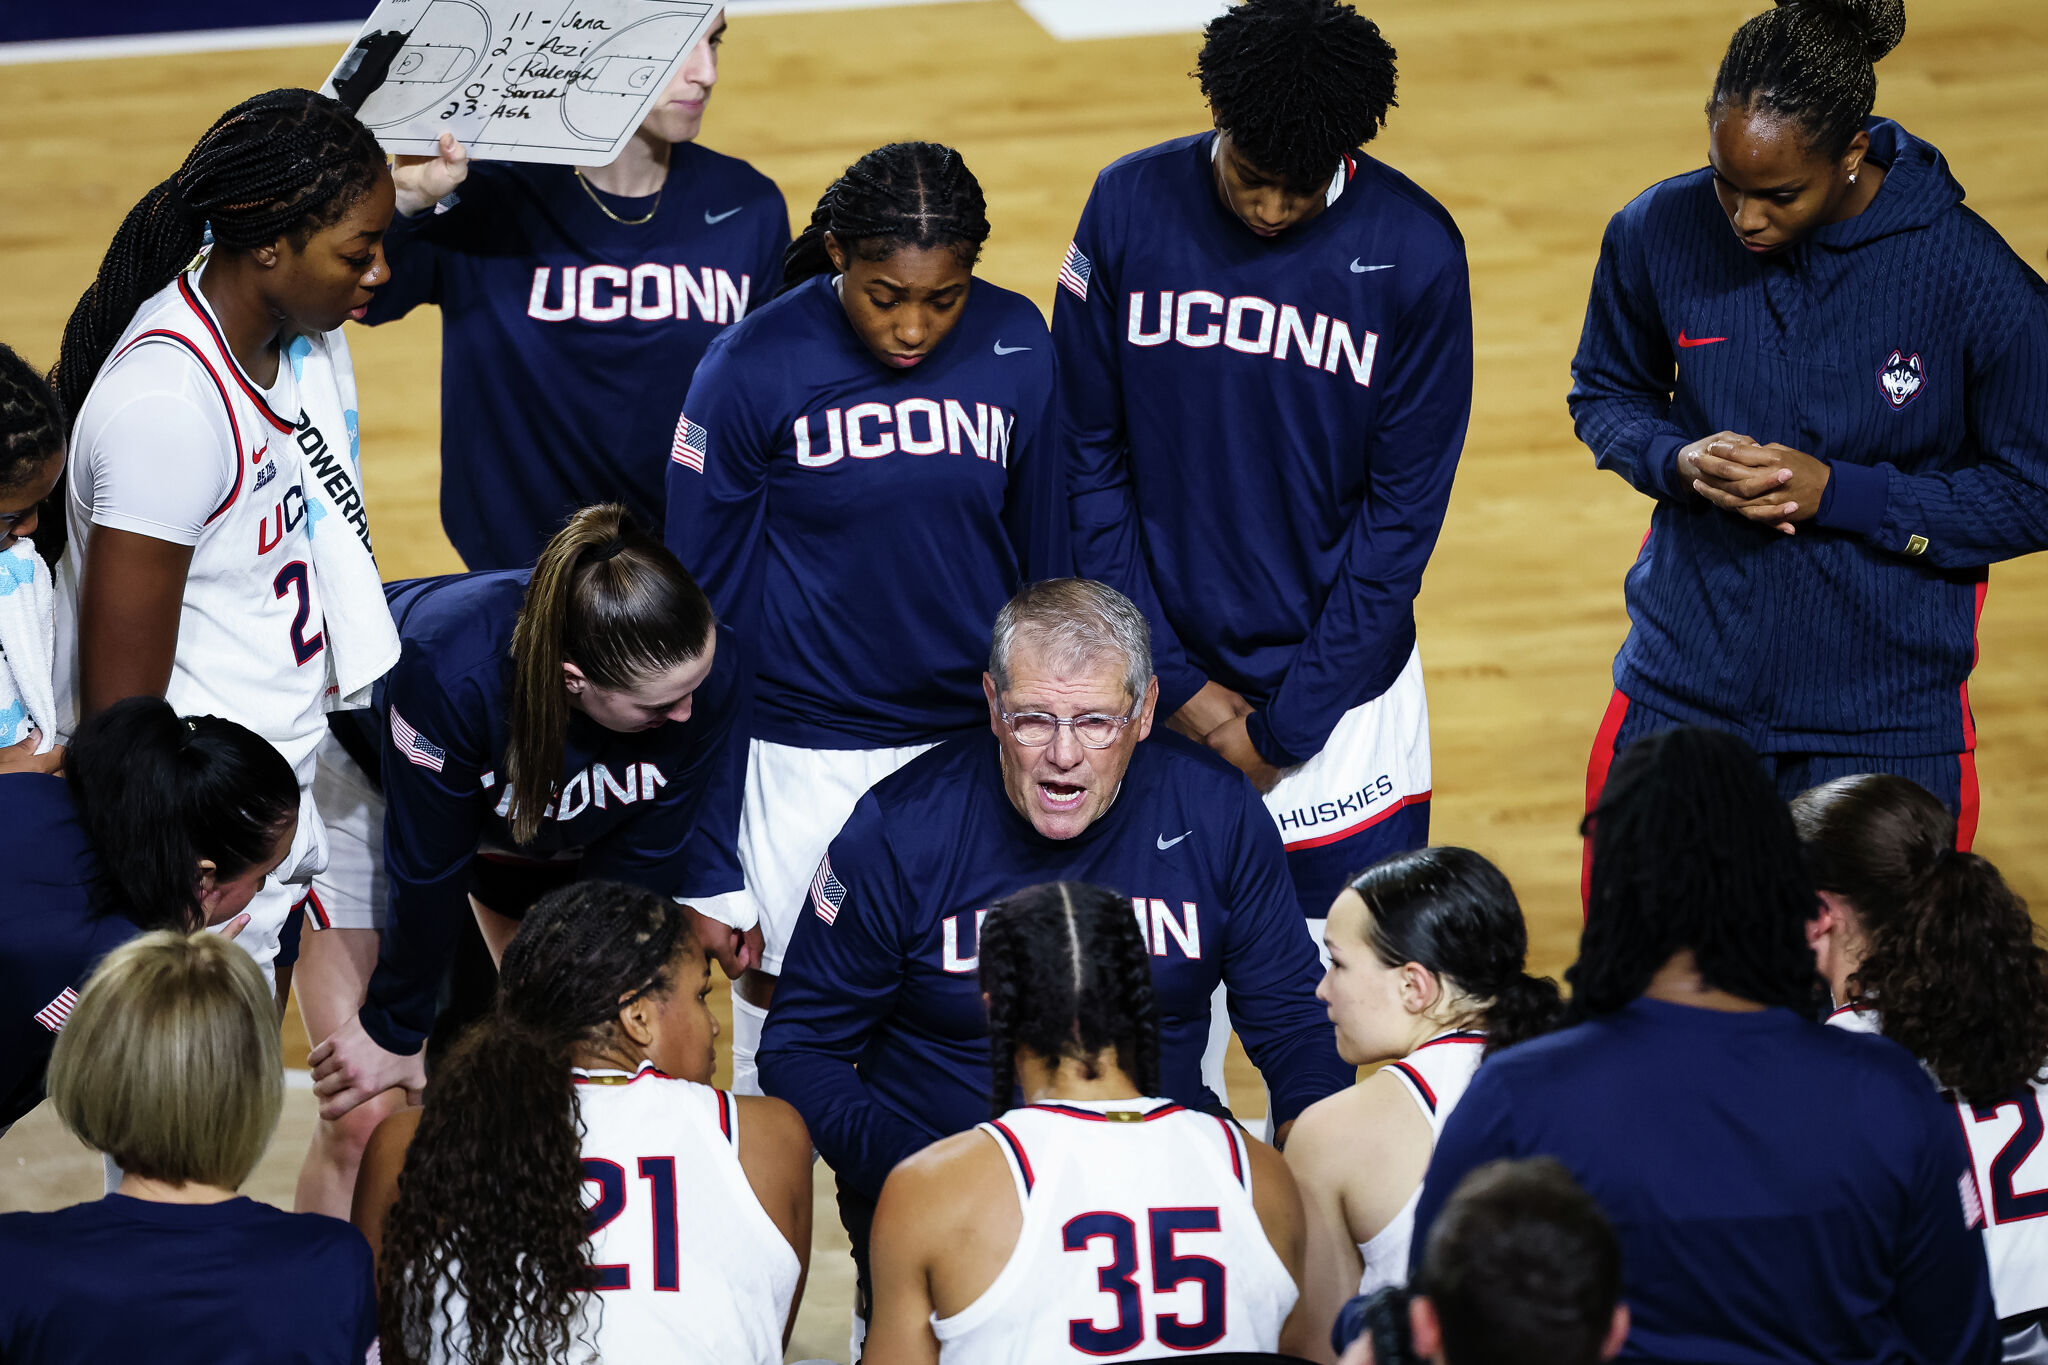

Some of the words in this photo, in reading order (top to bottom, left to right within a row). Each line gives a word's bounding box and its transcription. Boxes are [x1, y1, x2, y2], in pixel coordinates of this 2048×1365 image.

[492, 37, 512, 57] 2
[538, 36, 592, 57] Azzi
[509, 11, 533, 31] 11
[562, 11, 612, 30] Jana
[480, 63, 493, 78] 1
[520, 58, 597, 85] Kaleigh
[500, 83, 566, 99] Sarah
[440, 99, 478, 120] 23
[490, 104, 531, 119] Ash
[527, 262, 751, 325] UCONN
[1127, 290, 1379, 388] UCONN
[793, 397, 1014, 470] UCONN
[258, 485, 308, 555] UC
[295, 407, 380, 575] POWERAD
[273, 560, 329, 667] 2
[480, 762, 668, 820] ONN
[1278, 774, 1393, 830] HUSKIES
[1953, 1085, 2048, 1229] 2
[567, 1156, 680, 1292] 21
[1062, 1206, 1226, 1356] 35
